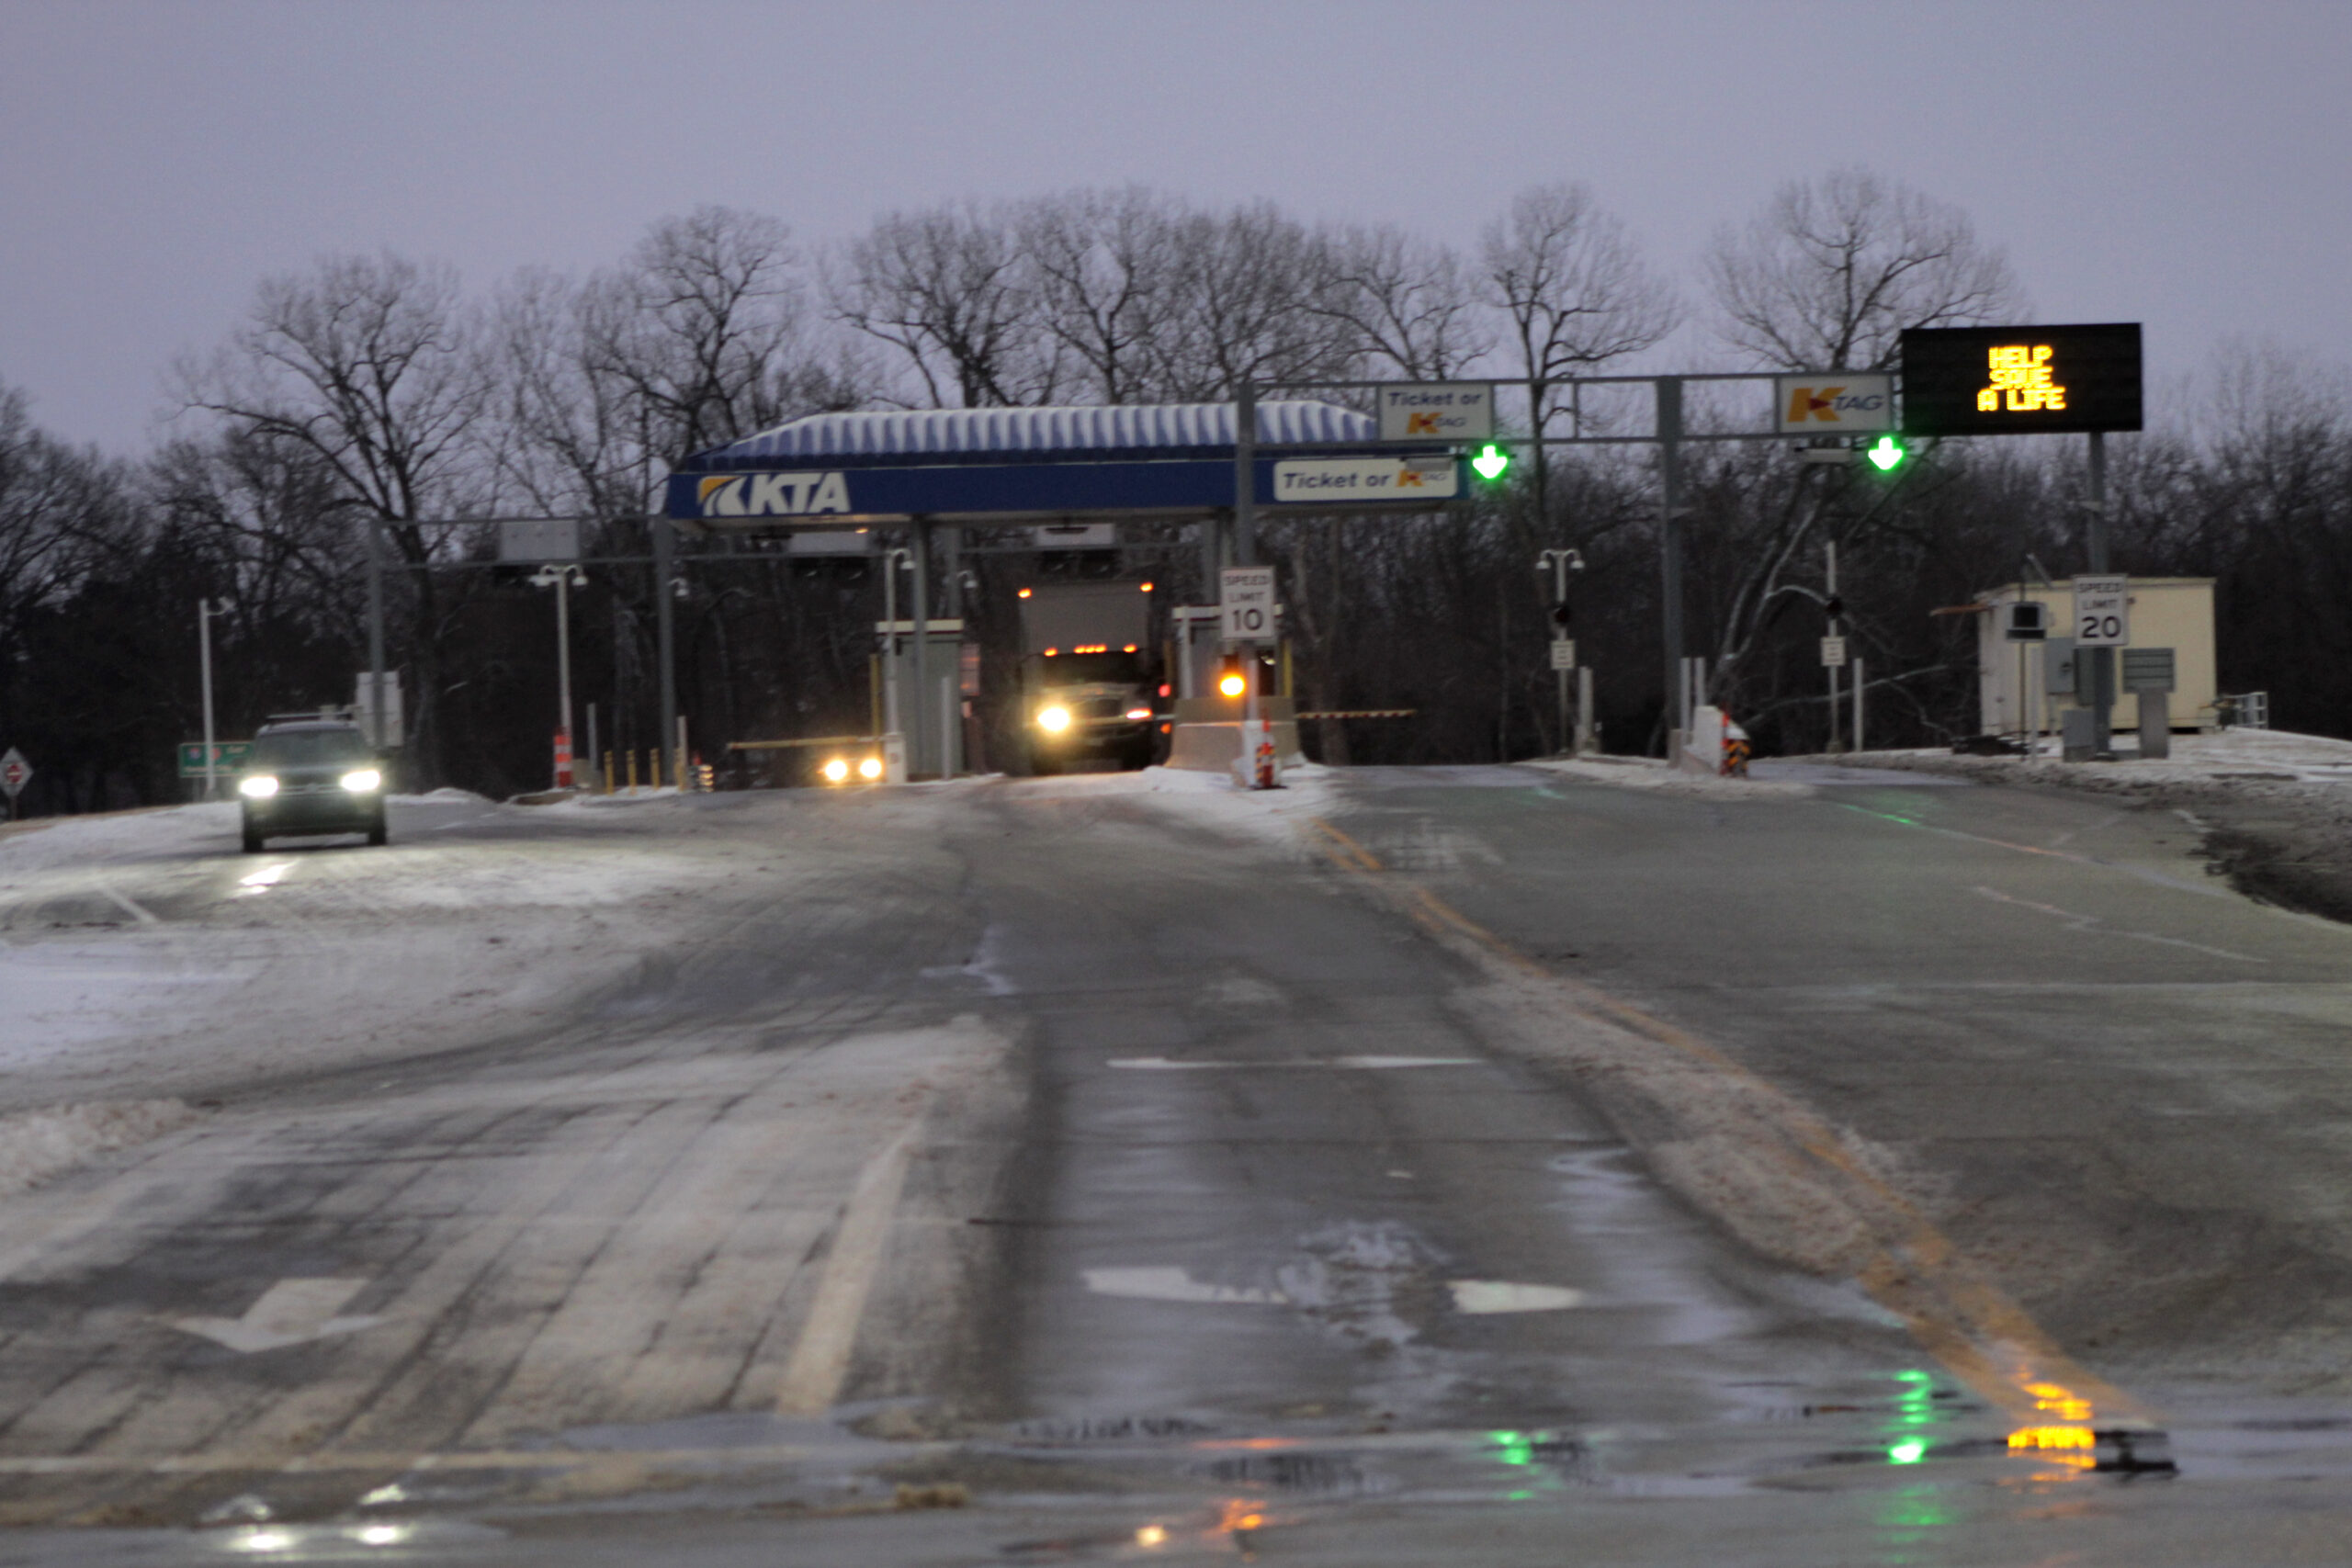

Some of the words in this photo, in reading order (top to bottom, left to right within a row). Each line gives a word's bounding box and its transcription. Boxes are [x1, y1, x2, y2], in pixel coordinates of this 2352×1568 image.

[1988, 344, 2053, 369] HELP
[1388, 391, 1453, 406] Ticket
[1460, 393, 1482, 405] or
[1976, 388, 1998, 412] A
[2006, 386, 2066, 411] LIFE
[748, 471, 852, 515] KTA
[1283, 471, 1359, 490] Ticket
[1365, 473, 1392, 488] or
[1233, 607, 1263, 632] 10
[2081, 615, 2122, 639] 20
